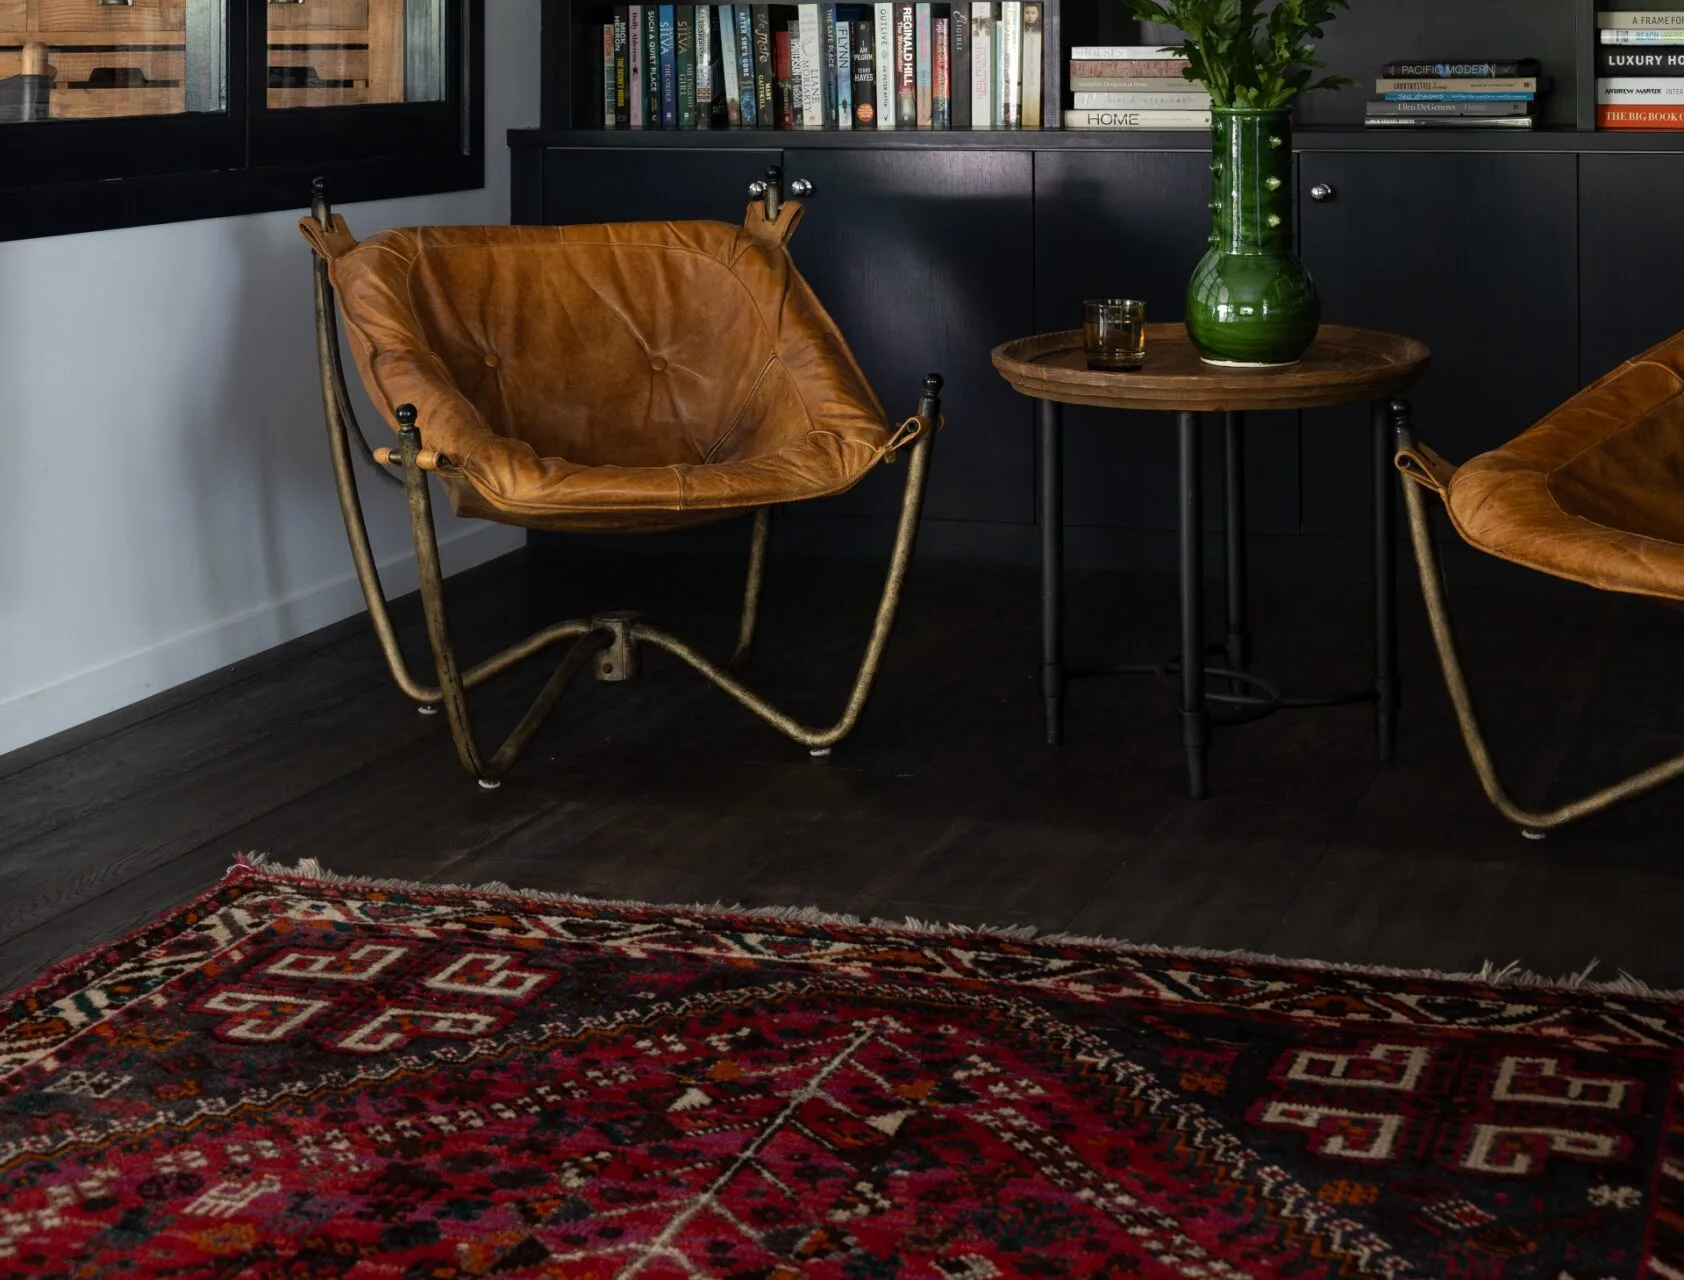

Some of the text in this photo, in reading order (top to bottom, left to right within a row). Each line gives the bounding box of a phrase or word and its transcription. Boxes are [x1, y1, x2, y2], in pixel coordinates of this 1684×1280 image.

[614, 15, 622, 51] HERRON
[677, 20, 688, 55] SILVA
[880, 8, 888, 46] OUTLIVE
[1632, 16, 1638, 25] A
[1641, 16, 1668, 25] FRAME
[660, 21, 670, 55] SILVA
[838, 29, 849, 69] FLYNN
[903, 7, 913, 87] REGINALD HILL
[1401, 65, 1444, 75] PACIFIC
[1608, 55, 1663, 66] LUXURY
[811, 69, 819, 103] LIANE
[1087, 113, 1140, 126] HOME
[1398, 102, 1416, 111] Ellen
[1606, 112, 1678, 121] THE BIG BOOK
